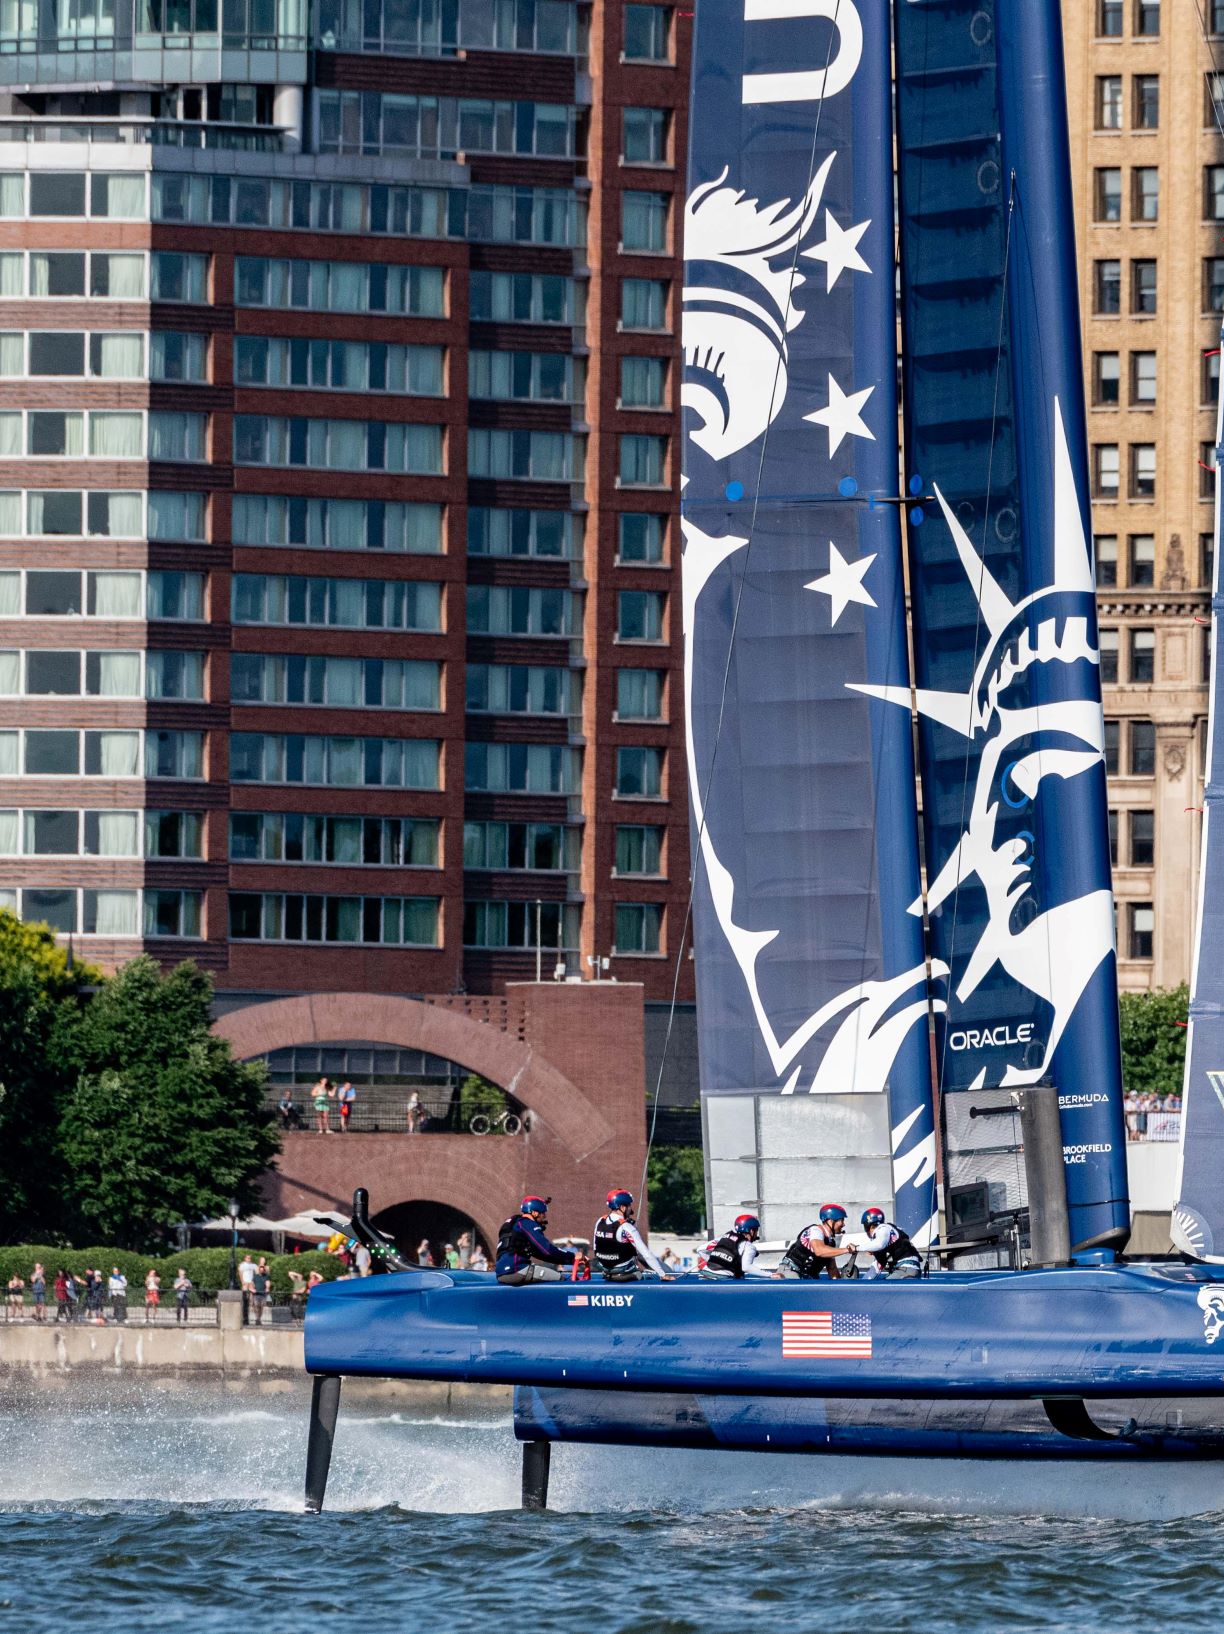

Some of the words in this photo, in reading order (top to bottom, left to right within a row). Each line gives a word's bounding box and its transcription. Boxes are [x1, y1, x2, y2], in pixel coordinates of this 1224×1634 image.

[949, 1023, 1032, 1051] ORACLE
[1058, 1094, 1109, 1105] BERMUDA
[590, 1295, 634, 1307] KIRBY
